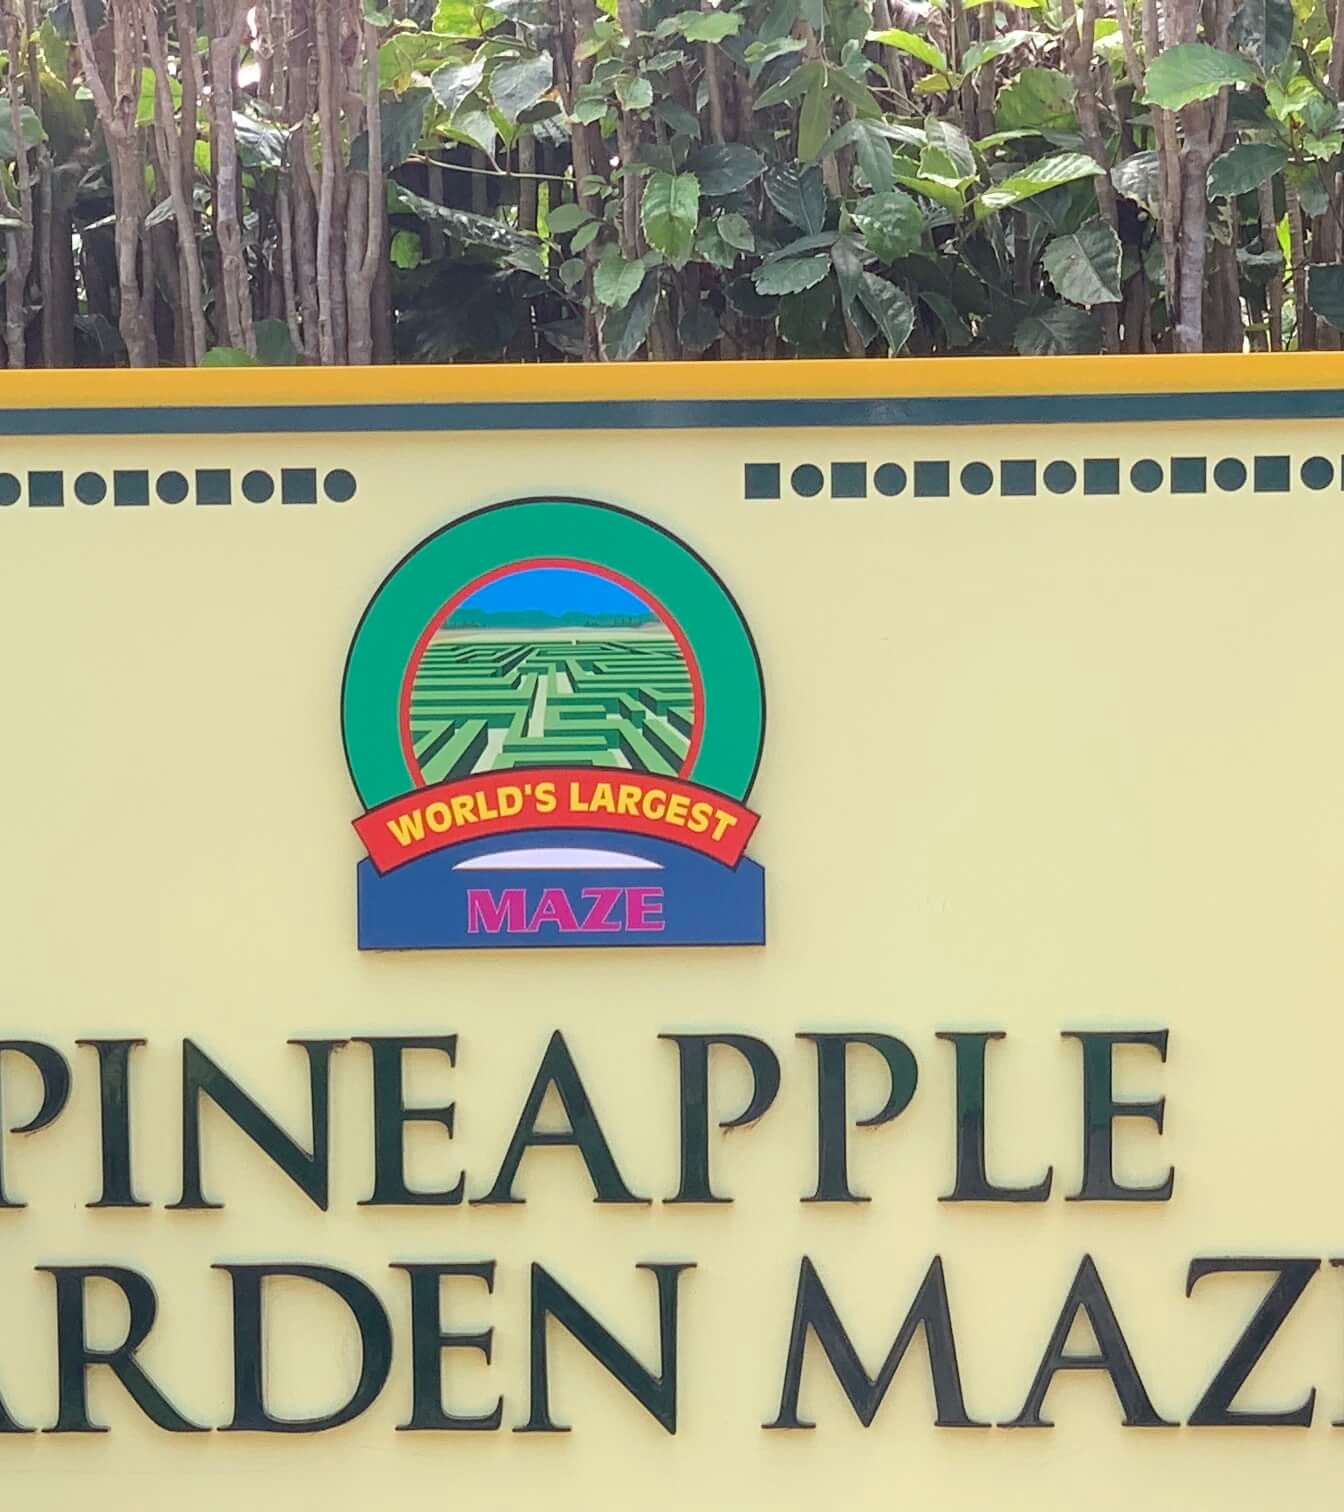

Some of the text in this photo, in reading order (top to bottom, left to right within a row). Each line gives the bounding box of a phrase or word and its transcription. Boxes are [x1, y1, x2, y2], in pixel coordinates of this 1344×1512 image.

[386, 781, 738, 847] WORLD'S LARGEST
[467, 886, 665, 934] MAZE
